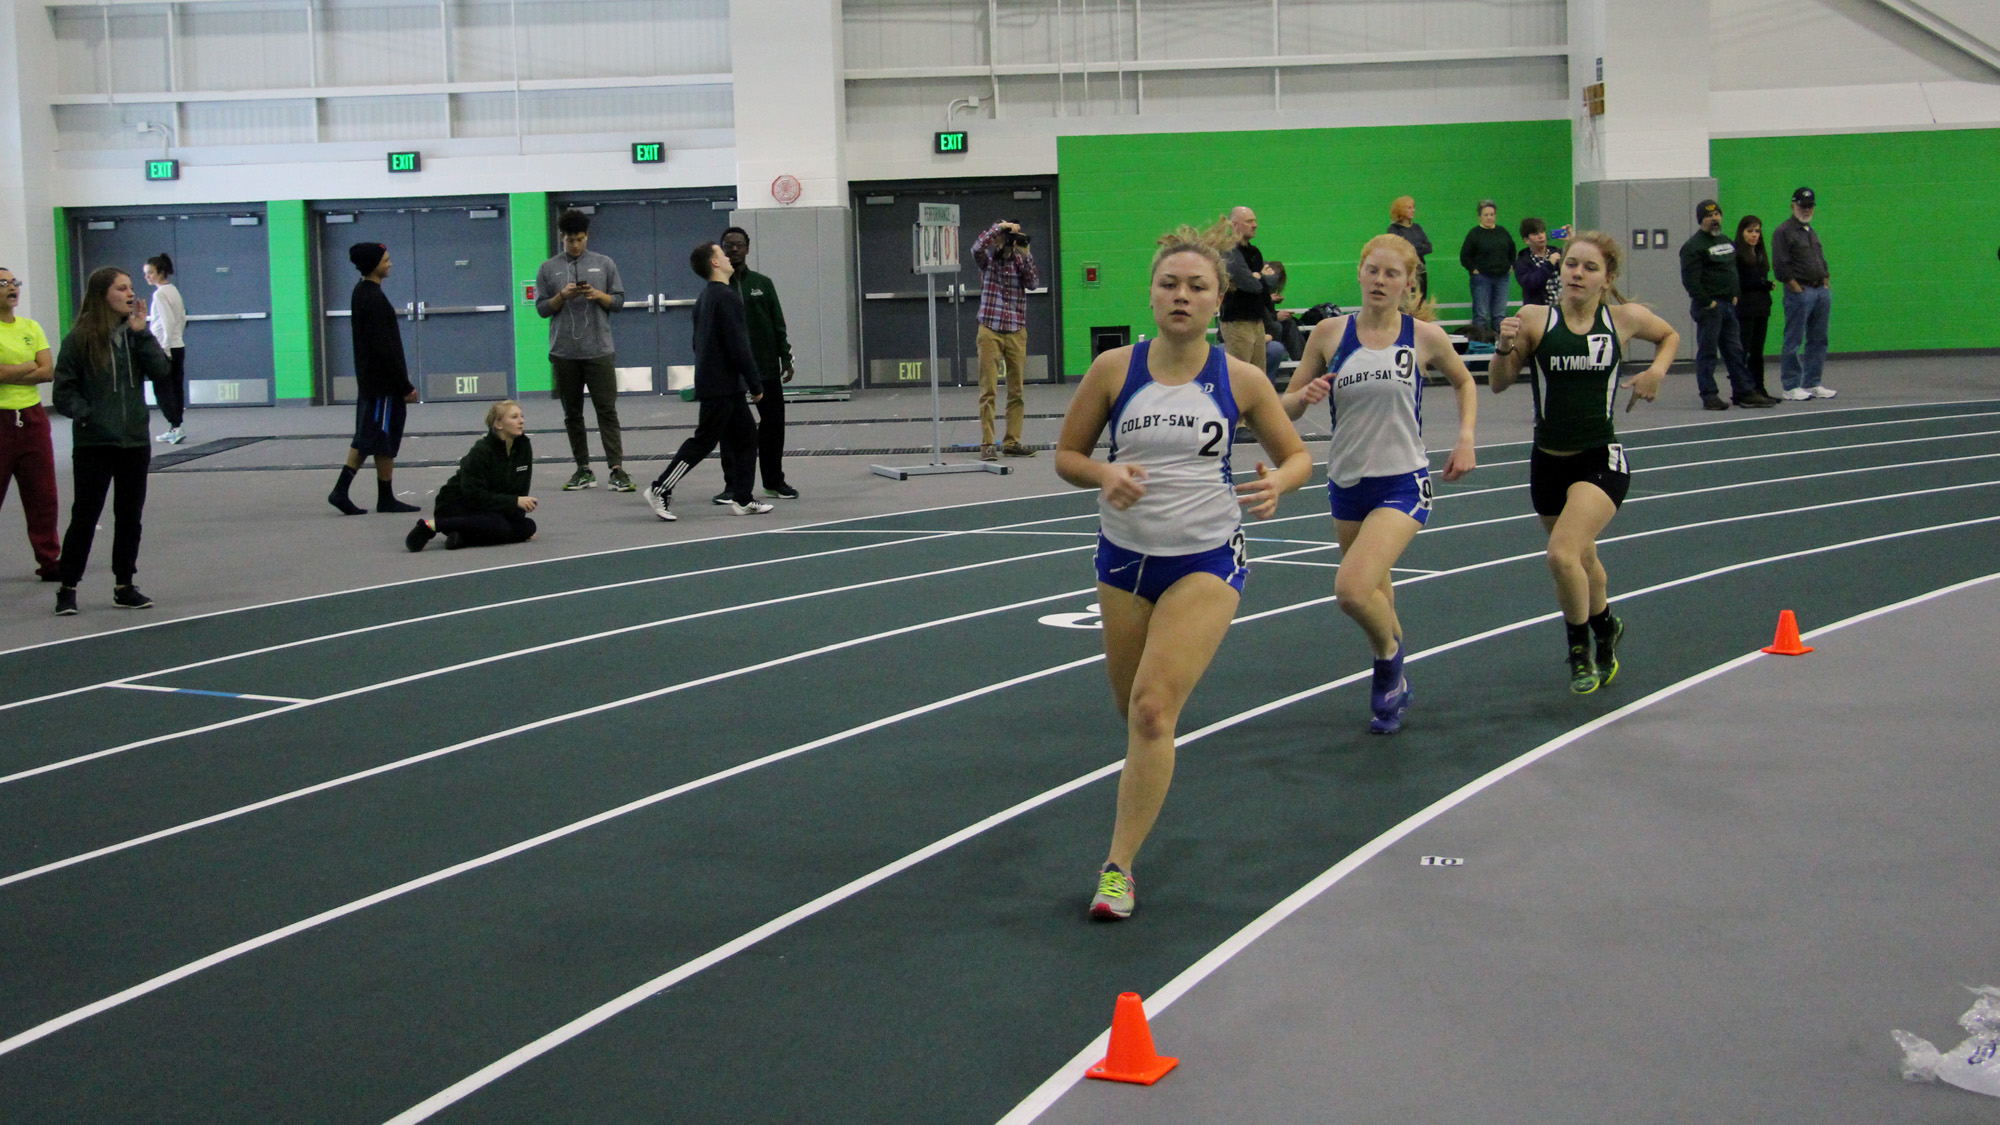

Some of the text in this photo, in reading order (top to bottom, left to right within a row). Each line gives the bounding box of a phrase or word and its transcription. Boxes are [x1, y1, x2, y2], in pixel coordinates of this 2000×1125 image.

[940, 133, 964, 151] EXIT
[392, 153, 416, 170] EXIT
[636, 144, 660, 161] EXIT
[150, 161, 174, 178] EXIT
[1591, 336, 1608, 363] 7
[899, 361, 922, 380] EXIT
[1395, 349, 1413, 379] 9
[1550, 355, 1606, 371] PLYMOU
[455, 376, 479, 394] EXIT
[1337, 369, 1413, 389] COLBY-SA
[217, 382, 240, 401] EXIT
[1121, 414, 1199, 435] COLBY-SAW
[1198, 420, 1223, 457] 2
[1610, 446, 1622, 472] 7
[1422, 479, 1432, 508] 9
[1232, 532, 1246, 567] 2
[1423, 856, 1458, 865] 10
